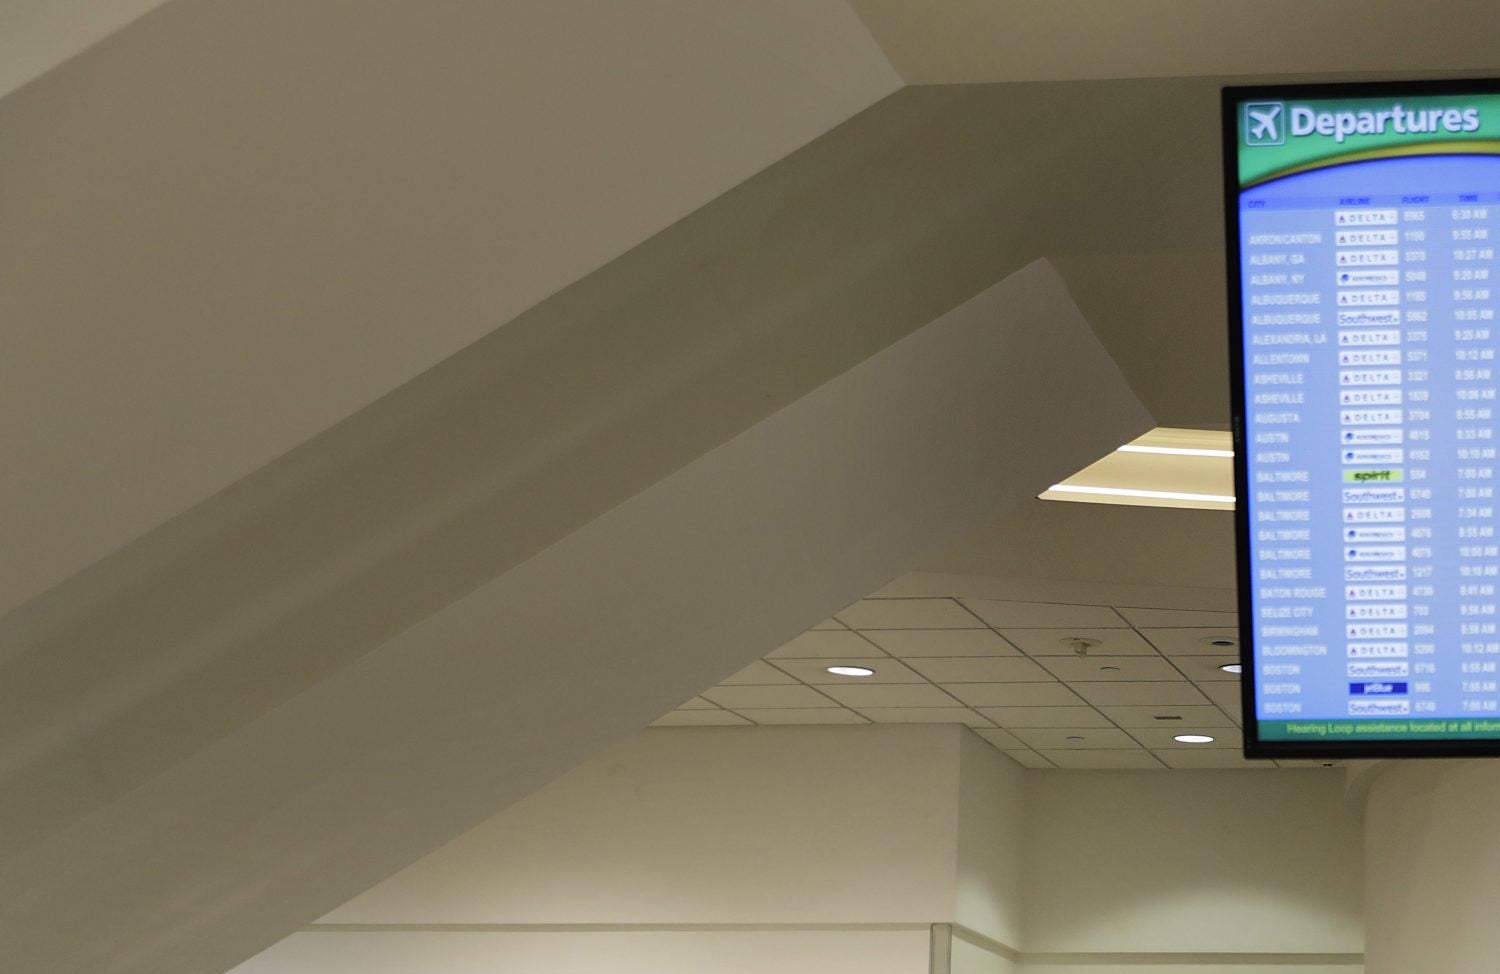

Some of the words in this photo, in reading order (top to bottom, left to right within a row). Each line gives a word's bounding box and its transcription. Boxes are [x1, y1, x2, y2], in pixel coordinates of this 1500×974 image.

[1290, 104, 1480, 142] Departures
[1348, 215, 1385, 224] DELTA
[1339, 314, 1392, 325] Southwest
[1352, 471, 1391, 483] spirit
[1343, 491, 1396, 502] Southwest
